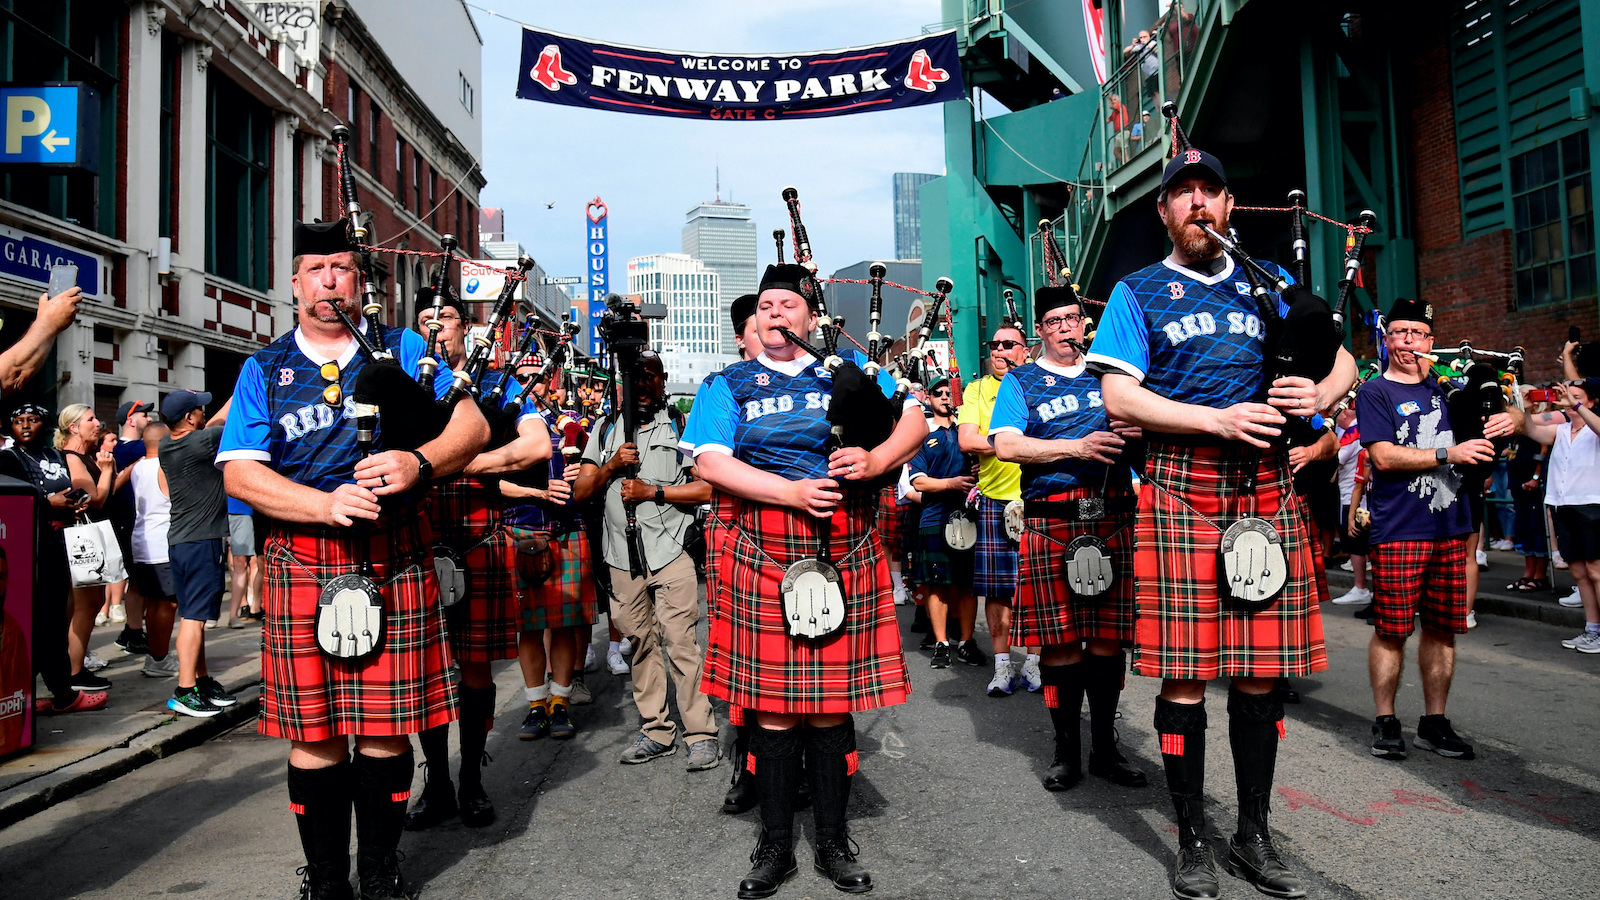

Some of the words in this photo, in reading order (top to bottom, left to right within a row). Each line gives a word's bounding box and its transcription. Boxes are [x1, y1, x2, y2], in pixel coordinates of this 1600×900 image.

[682, 58, 770, 71] WELCOME
[778, 59, 802, 70] TO
[591, 65, 765, 102] FENWAY
[774, 68, 891, 102] PARK
[6, 96, 51, 154] P
[710, 109, 755, 120] GATE
[764, 109, 775, 120] C
[1184, 149, 1202, 164] B
[590, 227, 605, 302] HOUSE
[1167, 281, 1186, 300] B
[1162, 312, 1217, 347] RED
[278, 367, 295, 387] B
[754, 373, 771, 387] B
[1043, 375, 1057, 387] B
[744, 394, 794, 422] RED
[804, 392, 832, 412] SO
[1036, 394, 1080, 423] RED
[279, 402, 334, 443] RED
